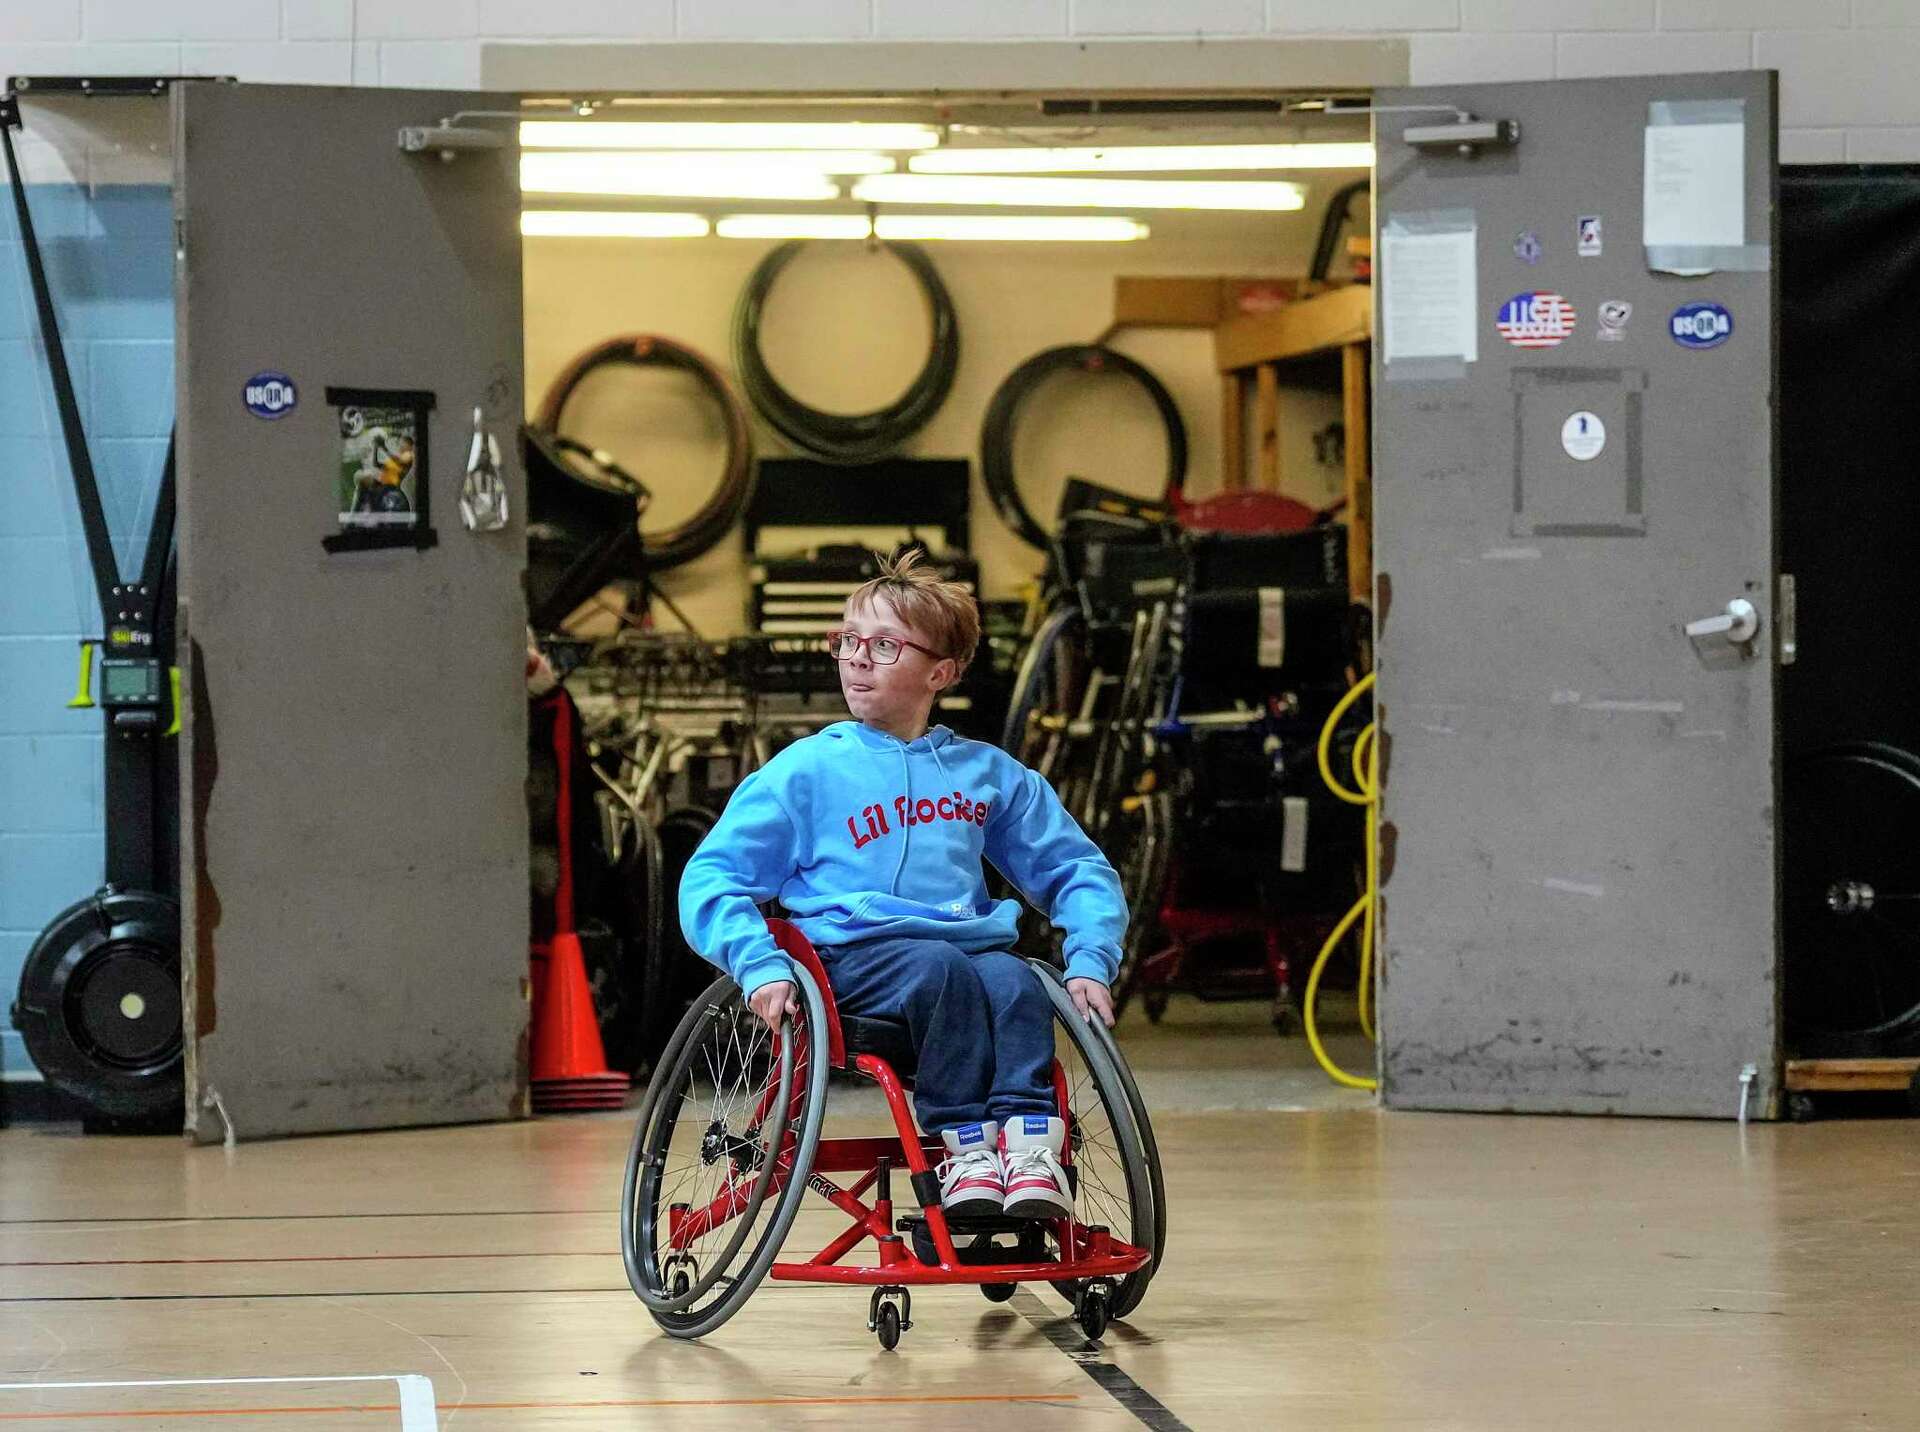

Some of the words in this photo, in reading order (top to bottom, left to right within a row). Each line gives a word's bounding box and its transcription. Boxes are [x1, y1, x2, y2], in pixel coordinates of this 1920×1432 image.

[1509, 295, 1564, 335] USA
[848, 804, 890, 849] Lil
[894, 791, 992, 828] Rocke
